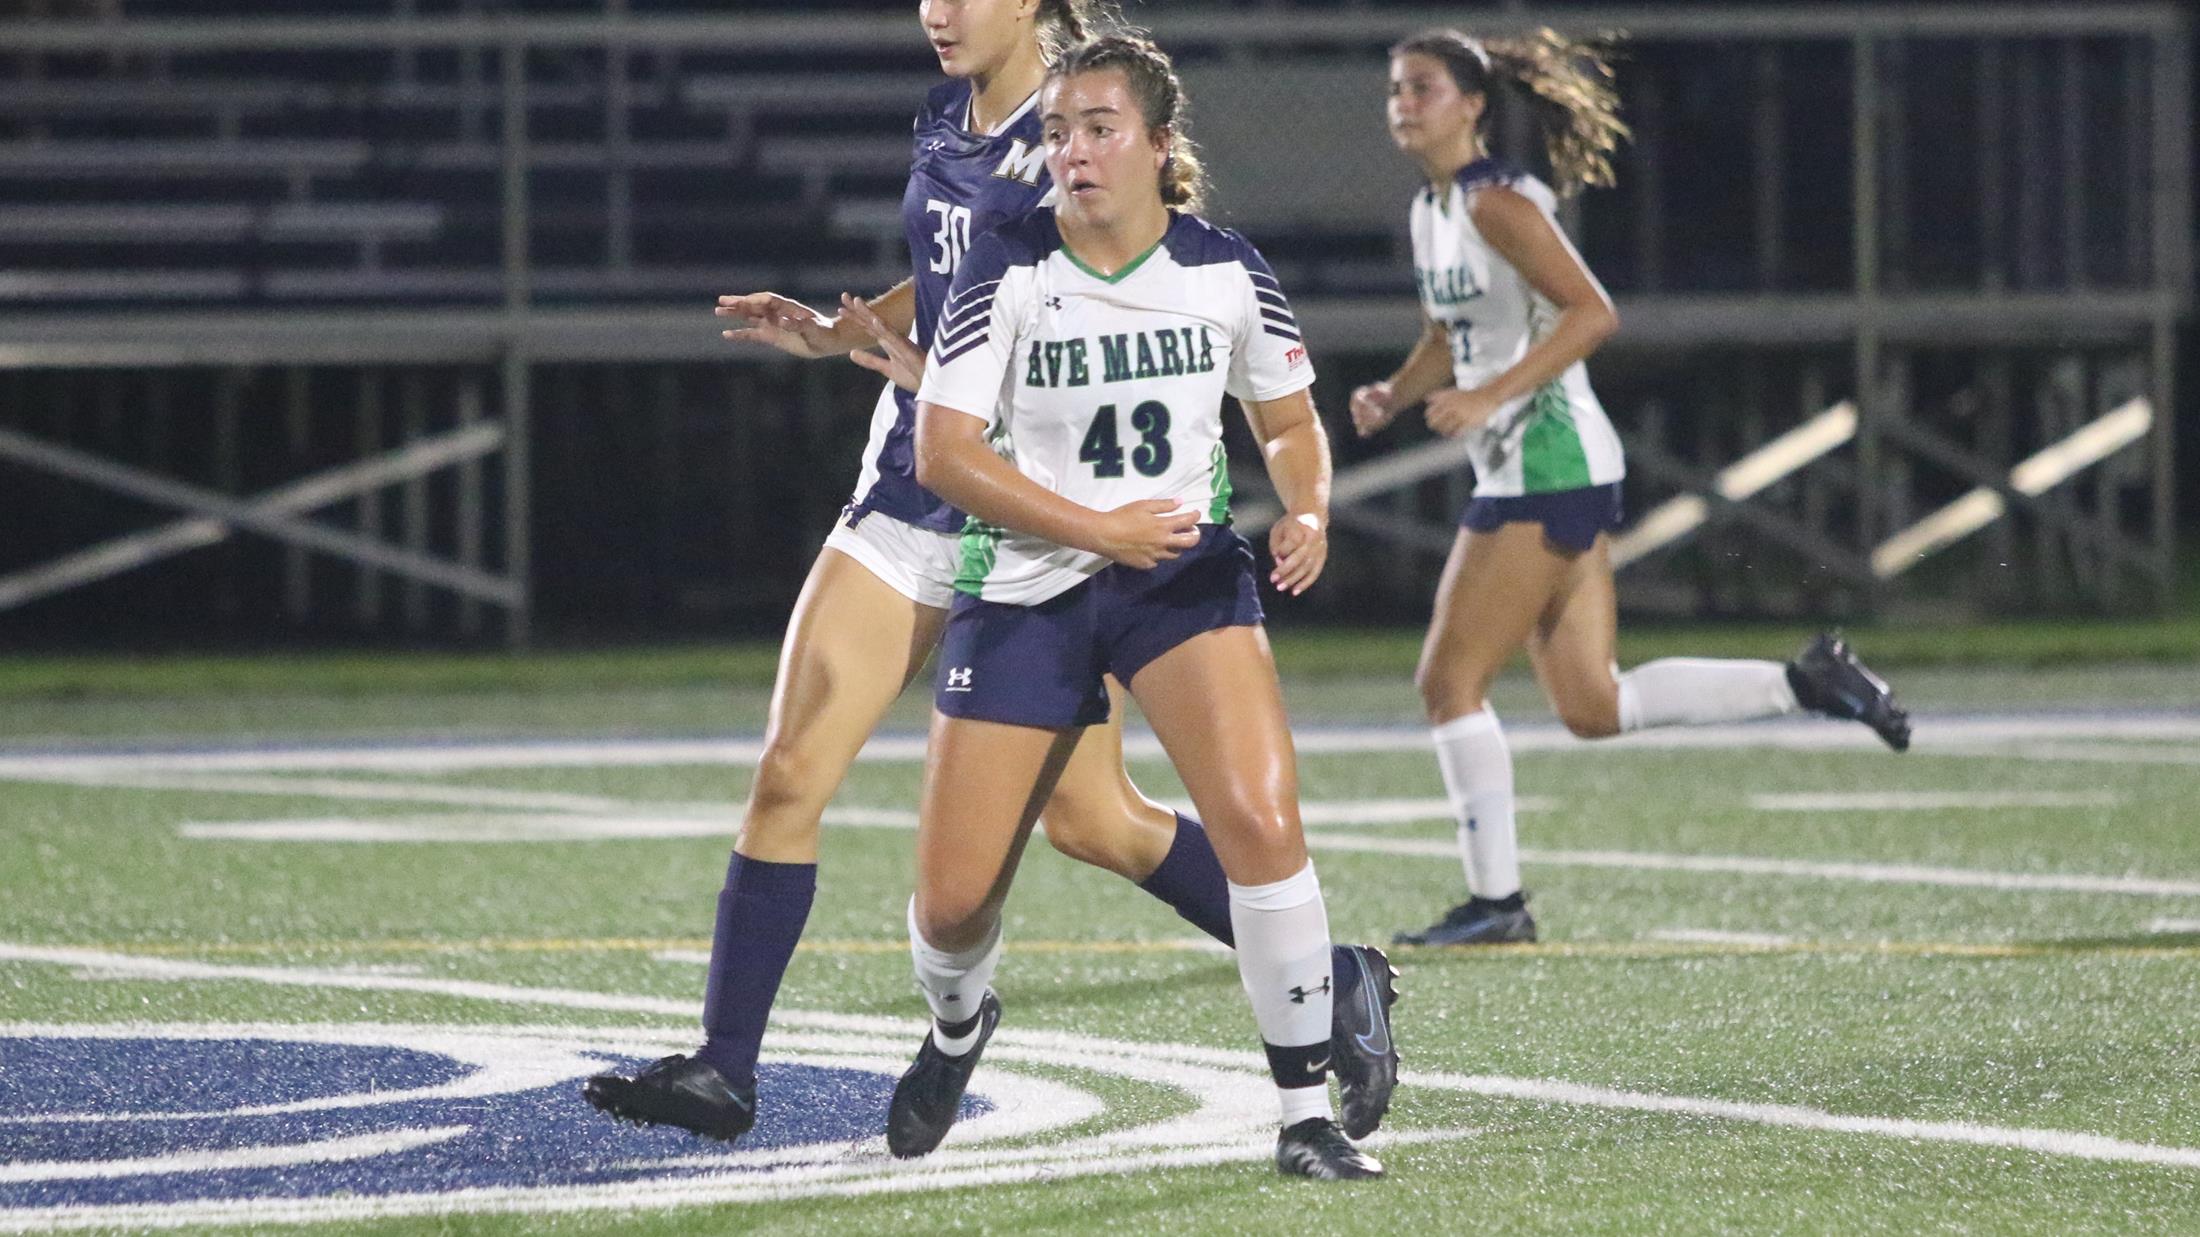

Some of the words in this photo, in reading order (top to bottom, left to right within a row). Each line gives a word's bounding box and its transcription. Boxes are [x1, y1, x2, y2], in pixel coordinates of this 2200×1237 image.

[991, 138, 1046, 186] M
[926, 199, 971, 276] 30
[1026, 338, 1090, 388] AVE
[1099, 325, 1215, 384] MARIA
[1079, 400, 1172, 479] 43
